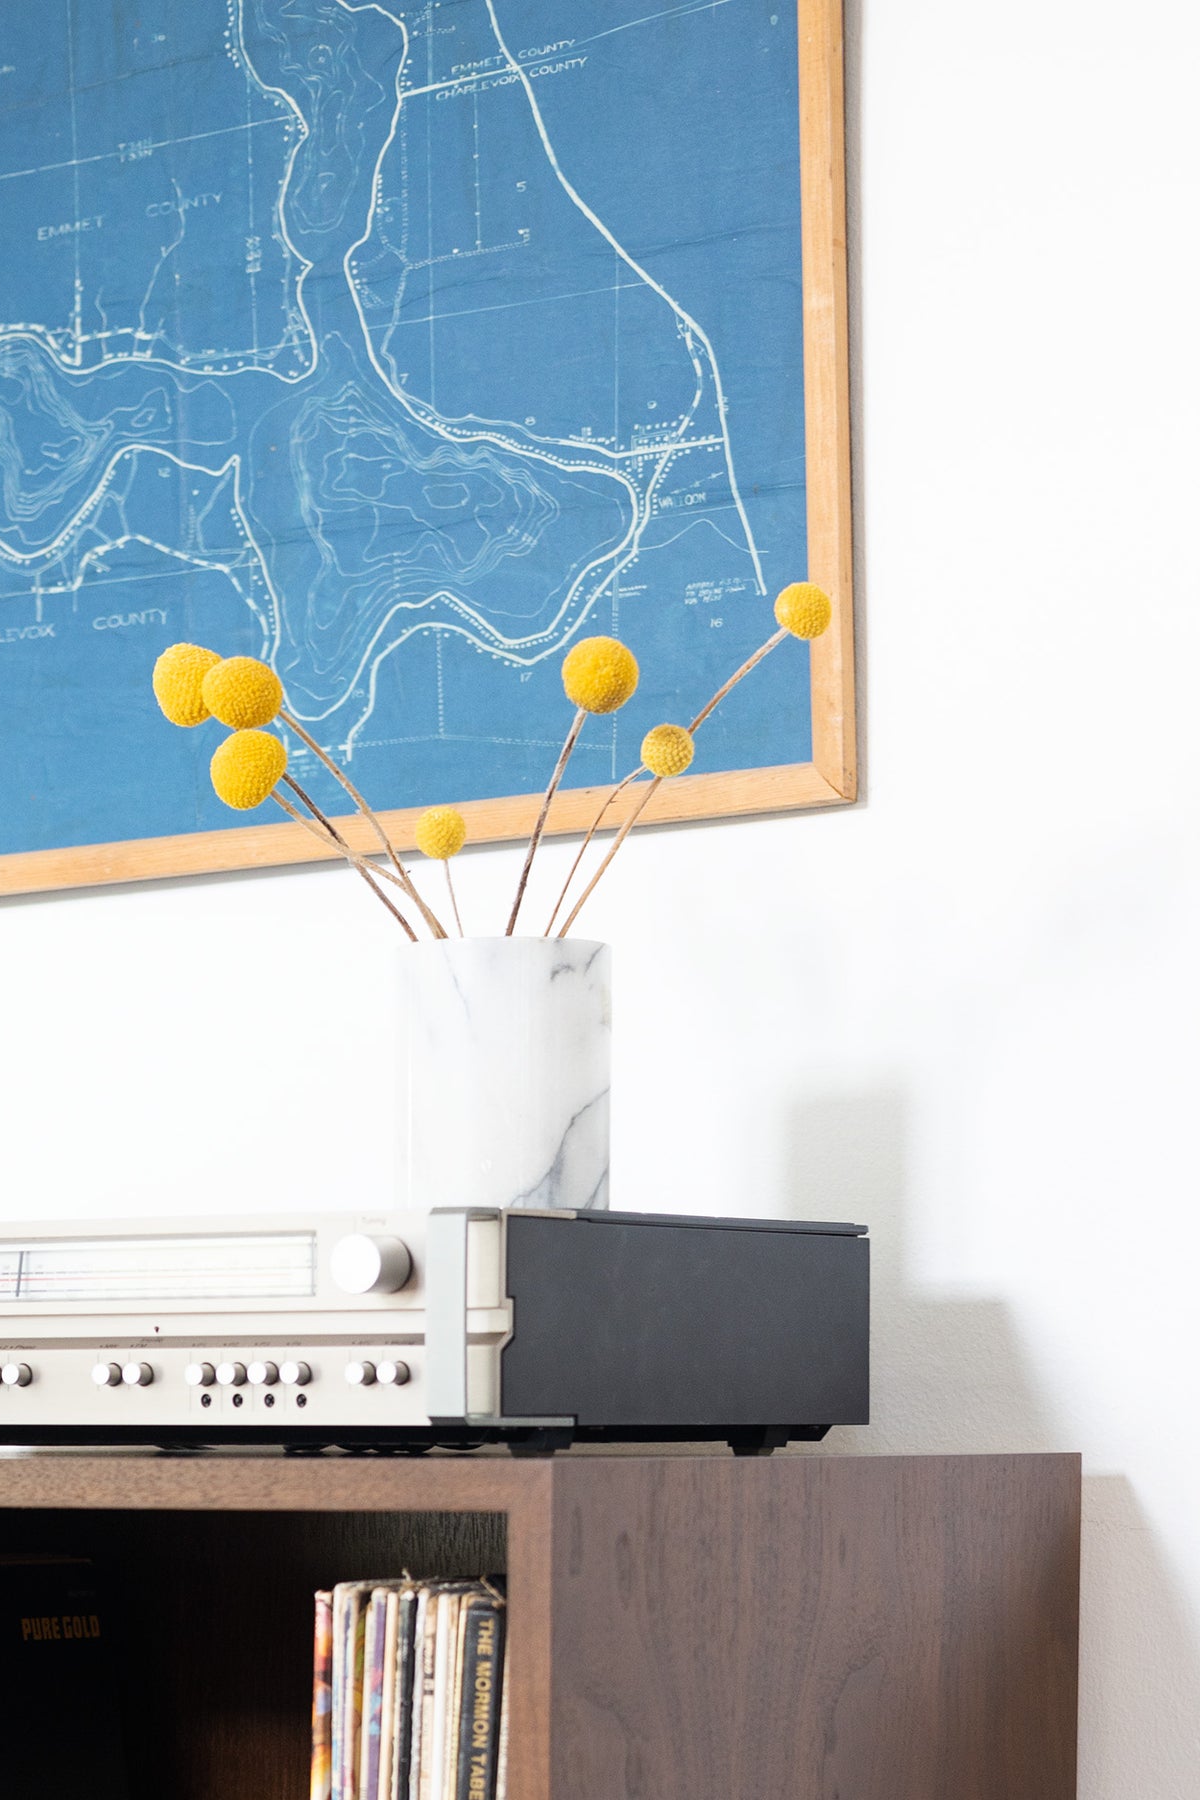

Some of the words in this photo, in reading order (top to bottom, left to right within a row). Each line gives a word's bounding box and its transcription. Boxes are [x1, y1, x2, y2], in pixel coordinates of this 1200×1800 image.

[452, 56, 504, 75] EMMET
[519, 40, 575, 59] COUNTY
[529, 57, 588, 78] COUNTY
[516, 181, 527, 193] 5
[35, 216, 104, 241] EMMET
[146, 193, 222, 218] COUNTY
[93, 607, 171, 630] COUNTY
[710, 617, 724, 629] 16
[519, 672, 533, 683] 17
[21, 1617, 61, 1641] PURE
[62, 1615, 101, 1639] GOLD
[476, 1619, 495, 1654] THE
[471, 1661, 492, 1748] MORMON
